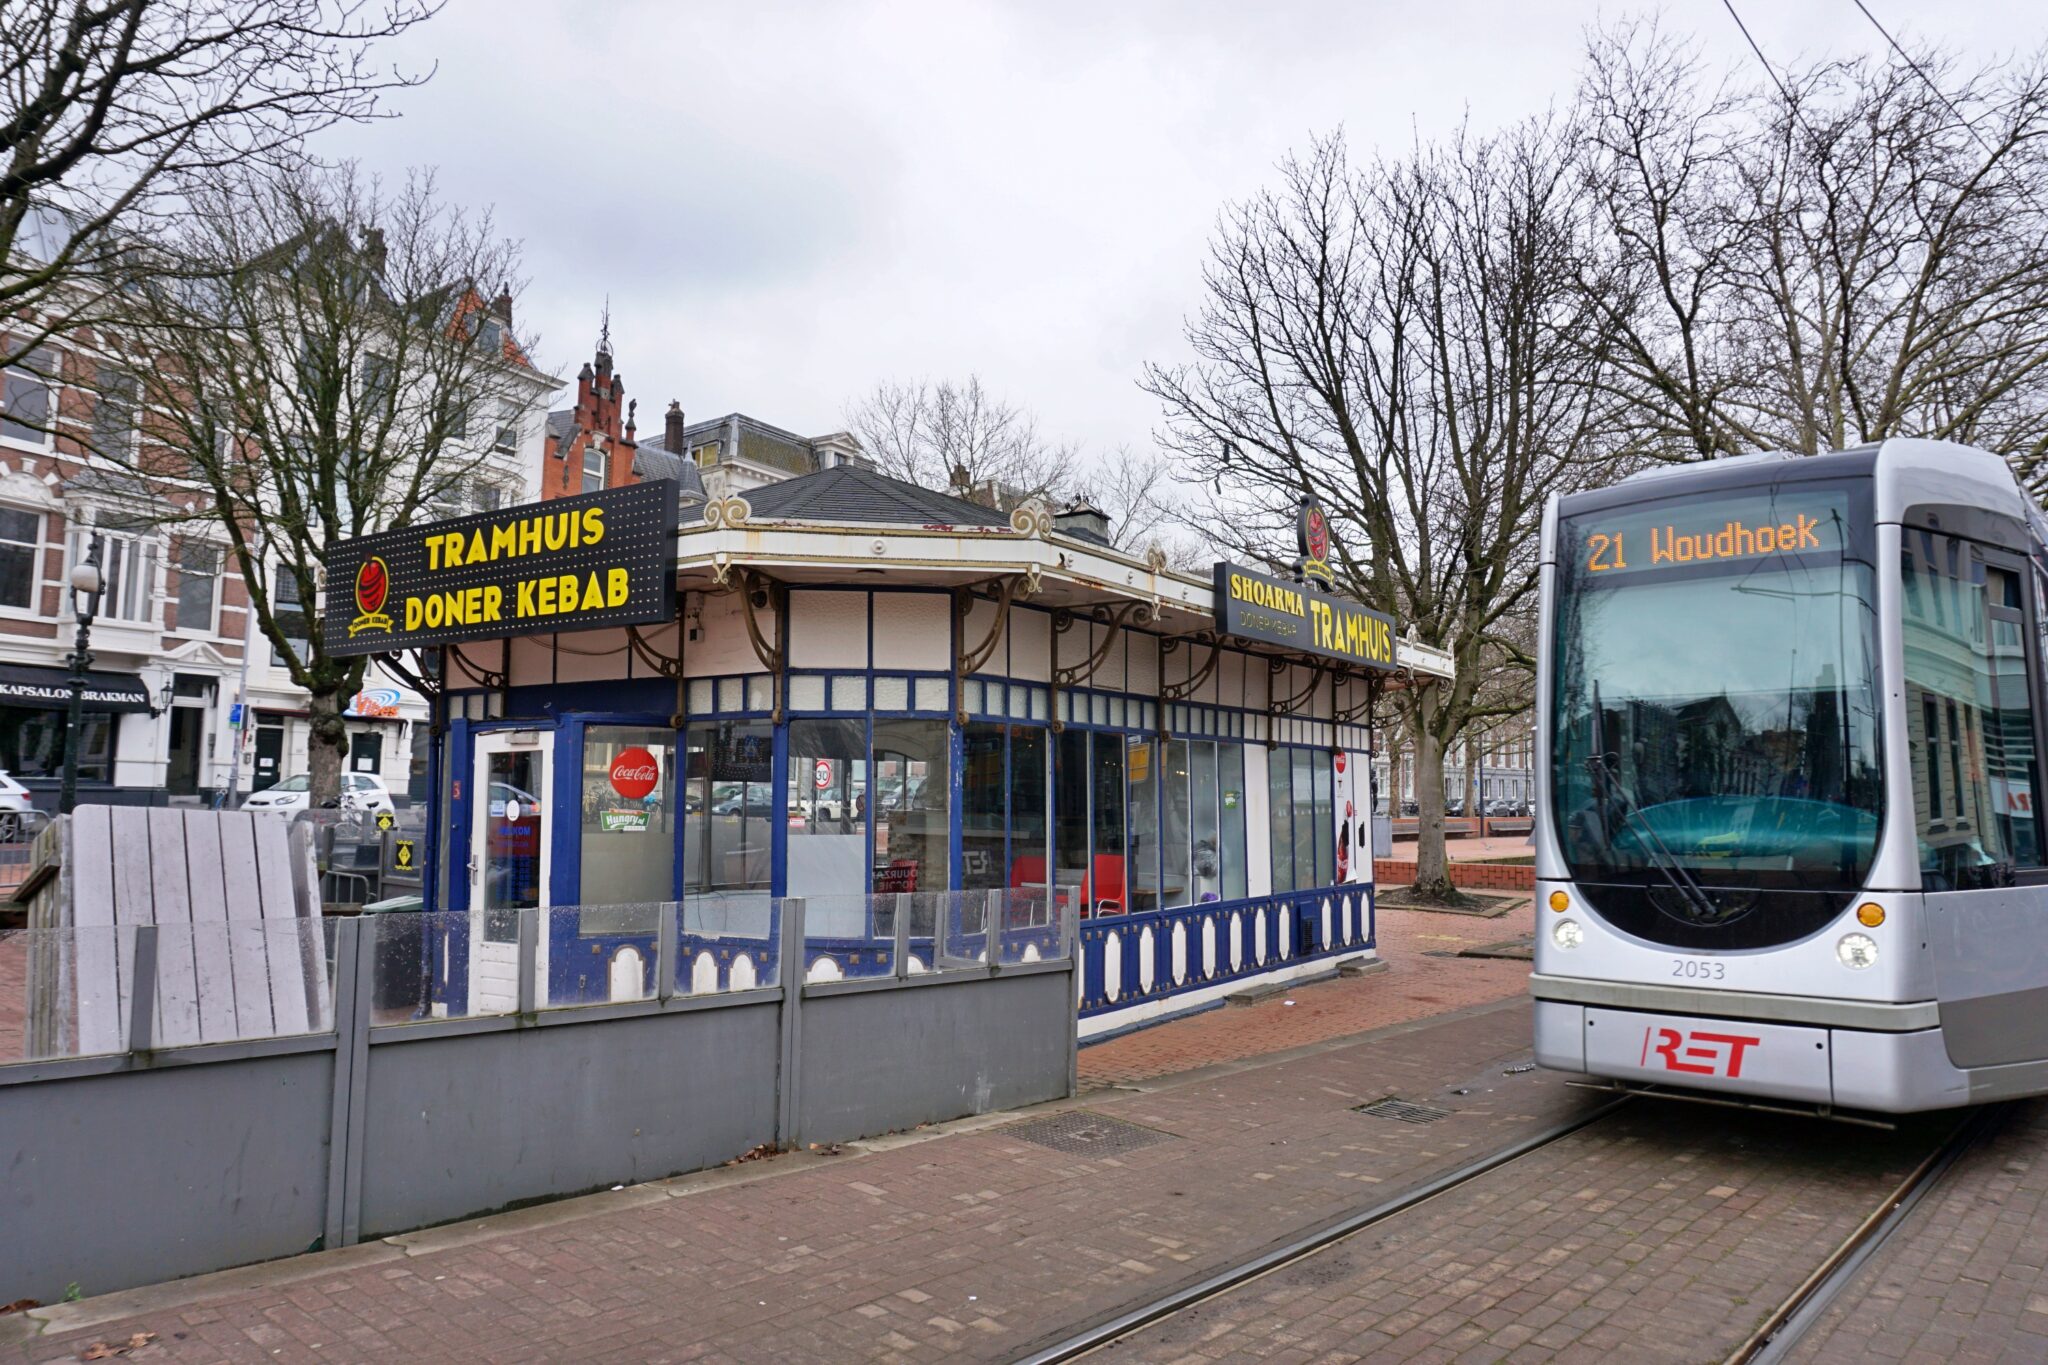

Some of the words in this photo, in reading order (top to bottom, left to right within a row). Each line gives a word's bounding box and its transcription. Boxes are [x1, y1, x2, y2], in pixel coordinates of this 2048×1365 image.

[425, 508, 605, 570] TRAMHUIS
[1587, 532, 1627, 571] 21
[1651, 514, 1820, 564] Woudhoek
[405, 585, 502, 631] DONER
[517, 568, 629, 618] KEBAB
[1230, 573, 1305, 617] SHOARMA
[1310, 599, 1392, 663] TRAMHUIS
[0, 684, 73, 699] KAPSALON
[81, 690, 145, 703] BRAKMAN
[816, 769, 827, 781] 30
[1672, 959, 1725, 980] 2053
[1656, 1028, 1760, 1078] RET
